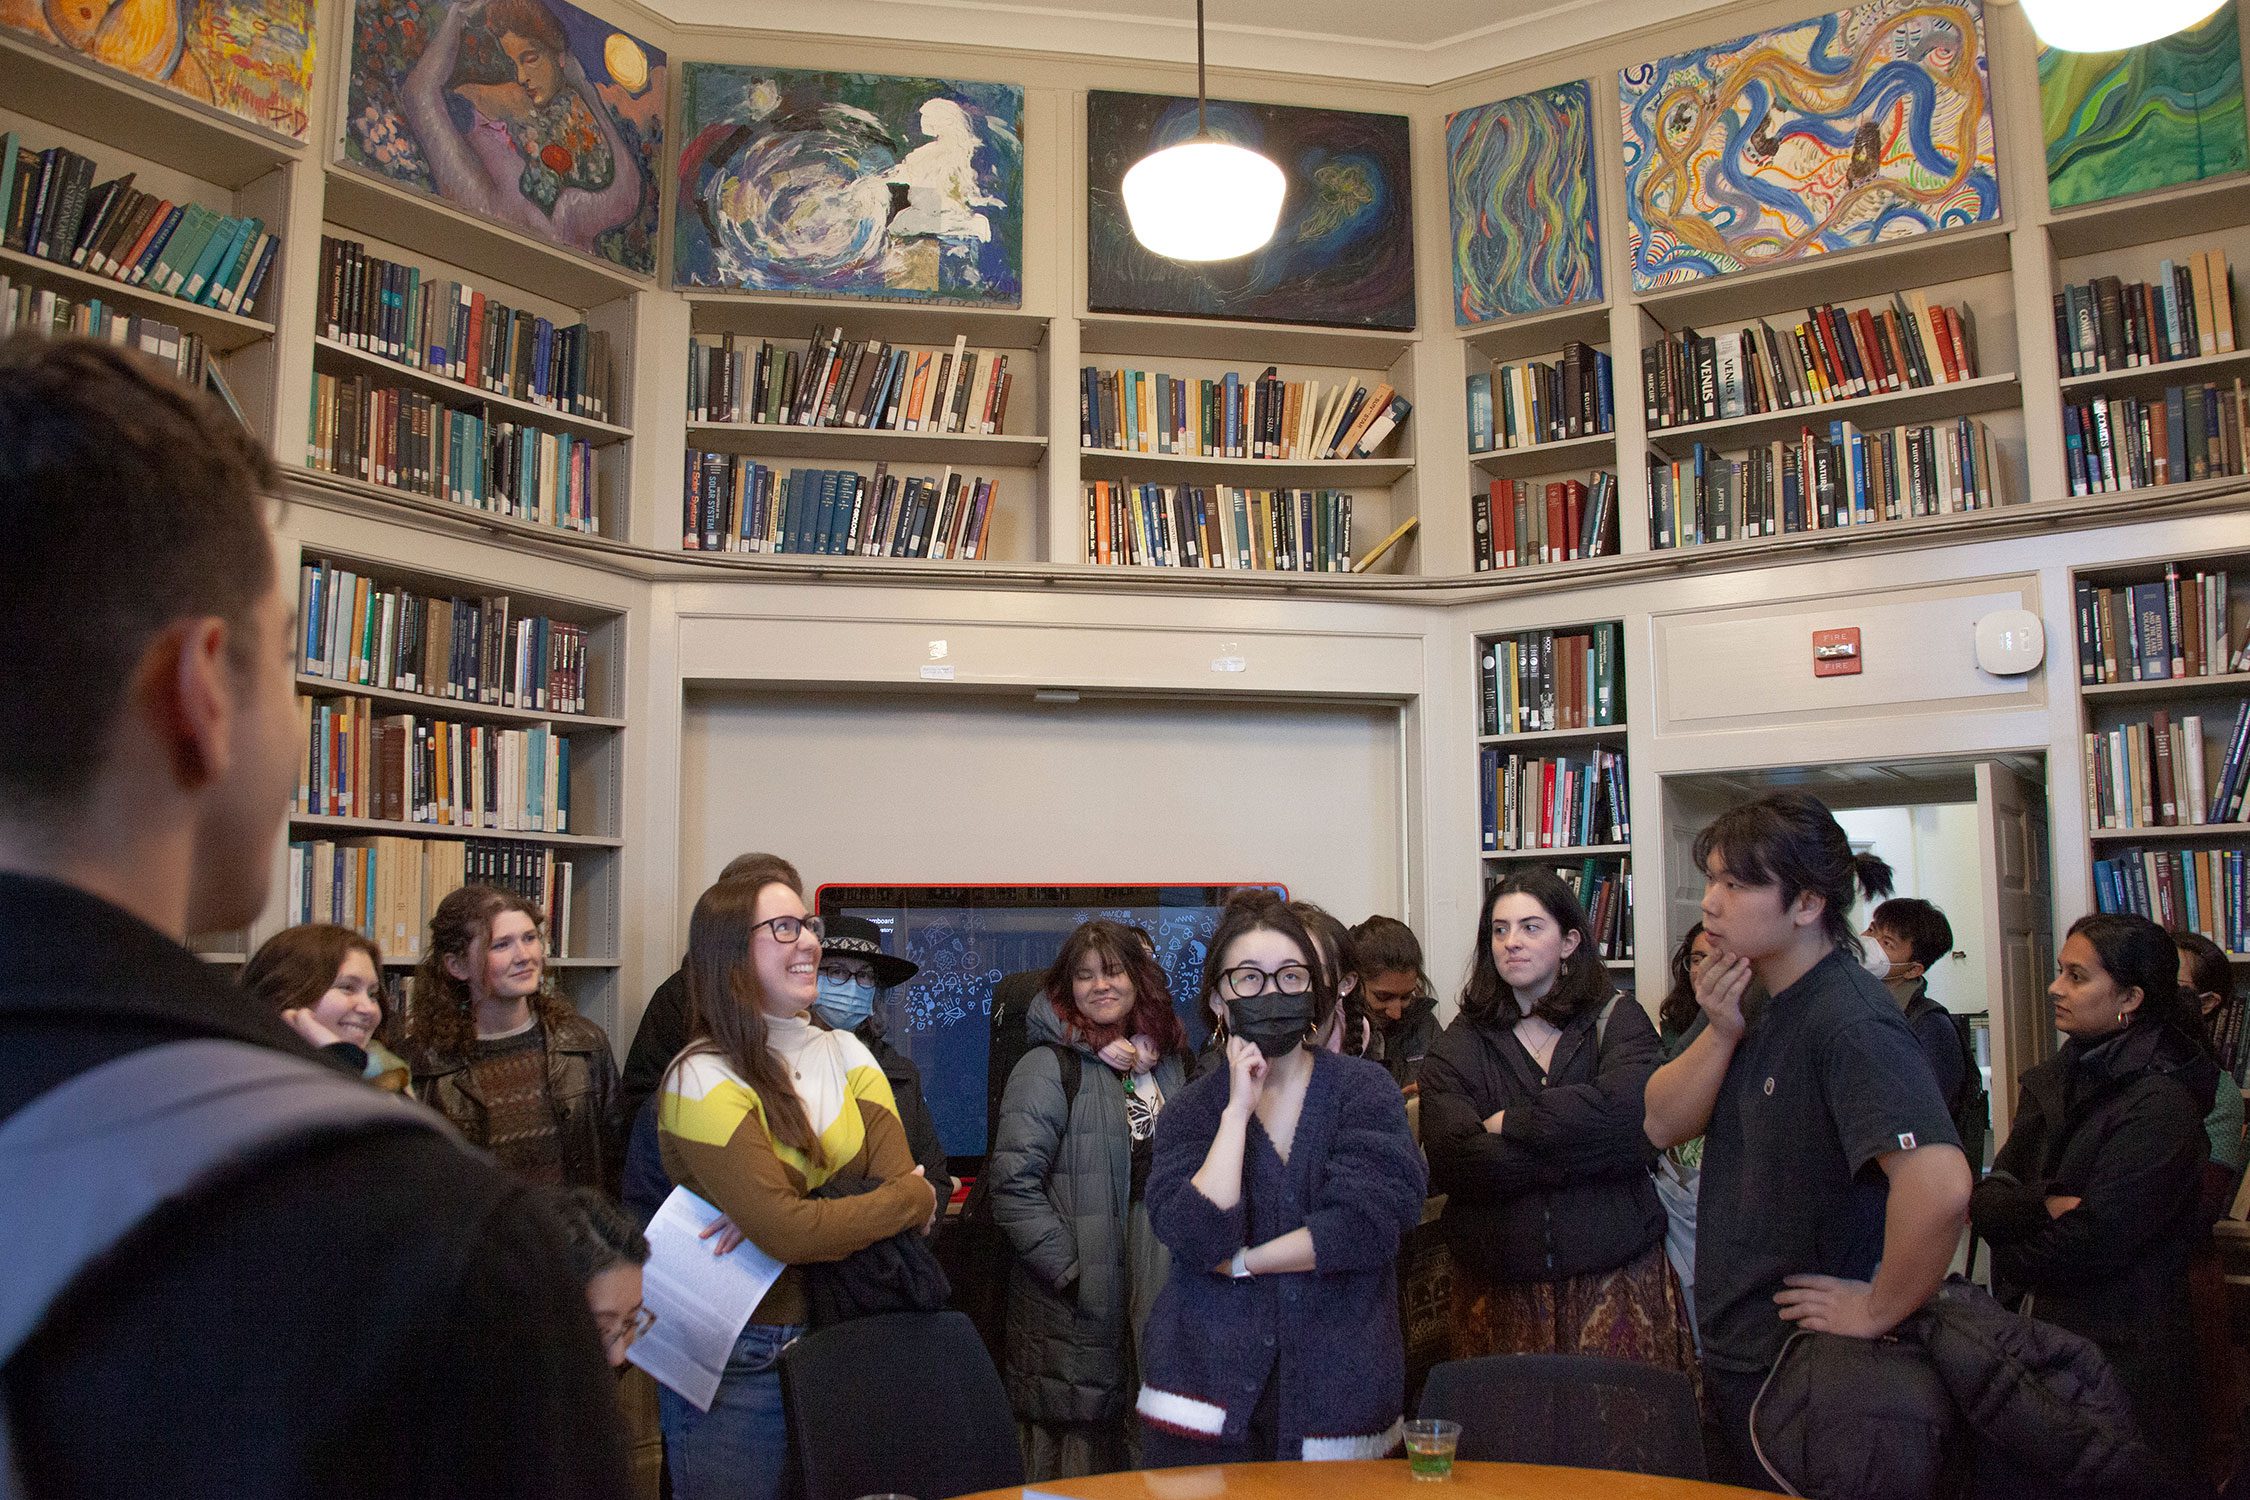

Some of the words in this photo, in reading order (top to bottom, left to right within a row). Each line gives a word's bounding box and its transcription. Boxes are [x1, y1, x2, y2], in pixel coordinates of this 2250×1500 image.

[332, 298, 340, 321] Century
[2079, 308, 2091, 345] COMETS
[1700, 358, 1714, 401] VENUS
[2097, 413, 2109, 447] COMETS
[692, 472, 700, 494] Solar
[708, 476, 717, 498] SOLAR
[1818, 459, 1828, 491] SATURN
[690, 496, 700, 528] System
[1717, 488, 1725, 512] JUPITER
[706, 500, 716, 530] SYSTEM
[2168, 596, 2179, 645] METEORITES
[1824, 633, 1848, 641] FIRE
[1825, 662, 1849, 670] FIRE
[2224, 755, 2232, 765] THE
[2135, 868, 2143, 882] THE
